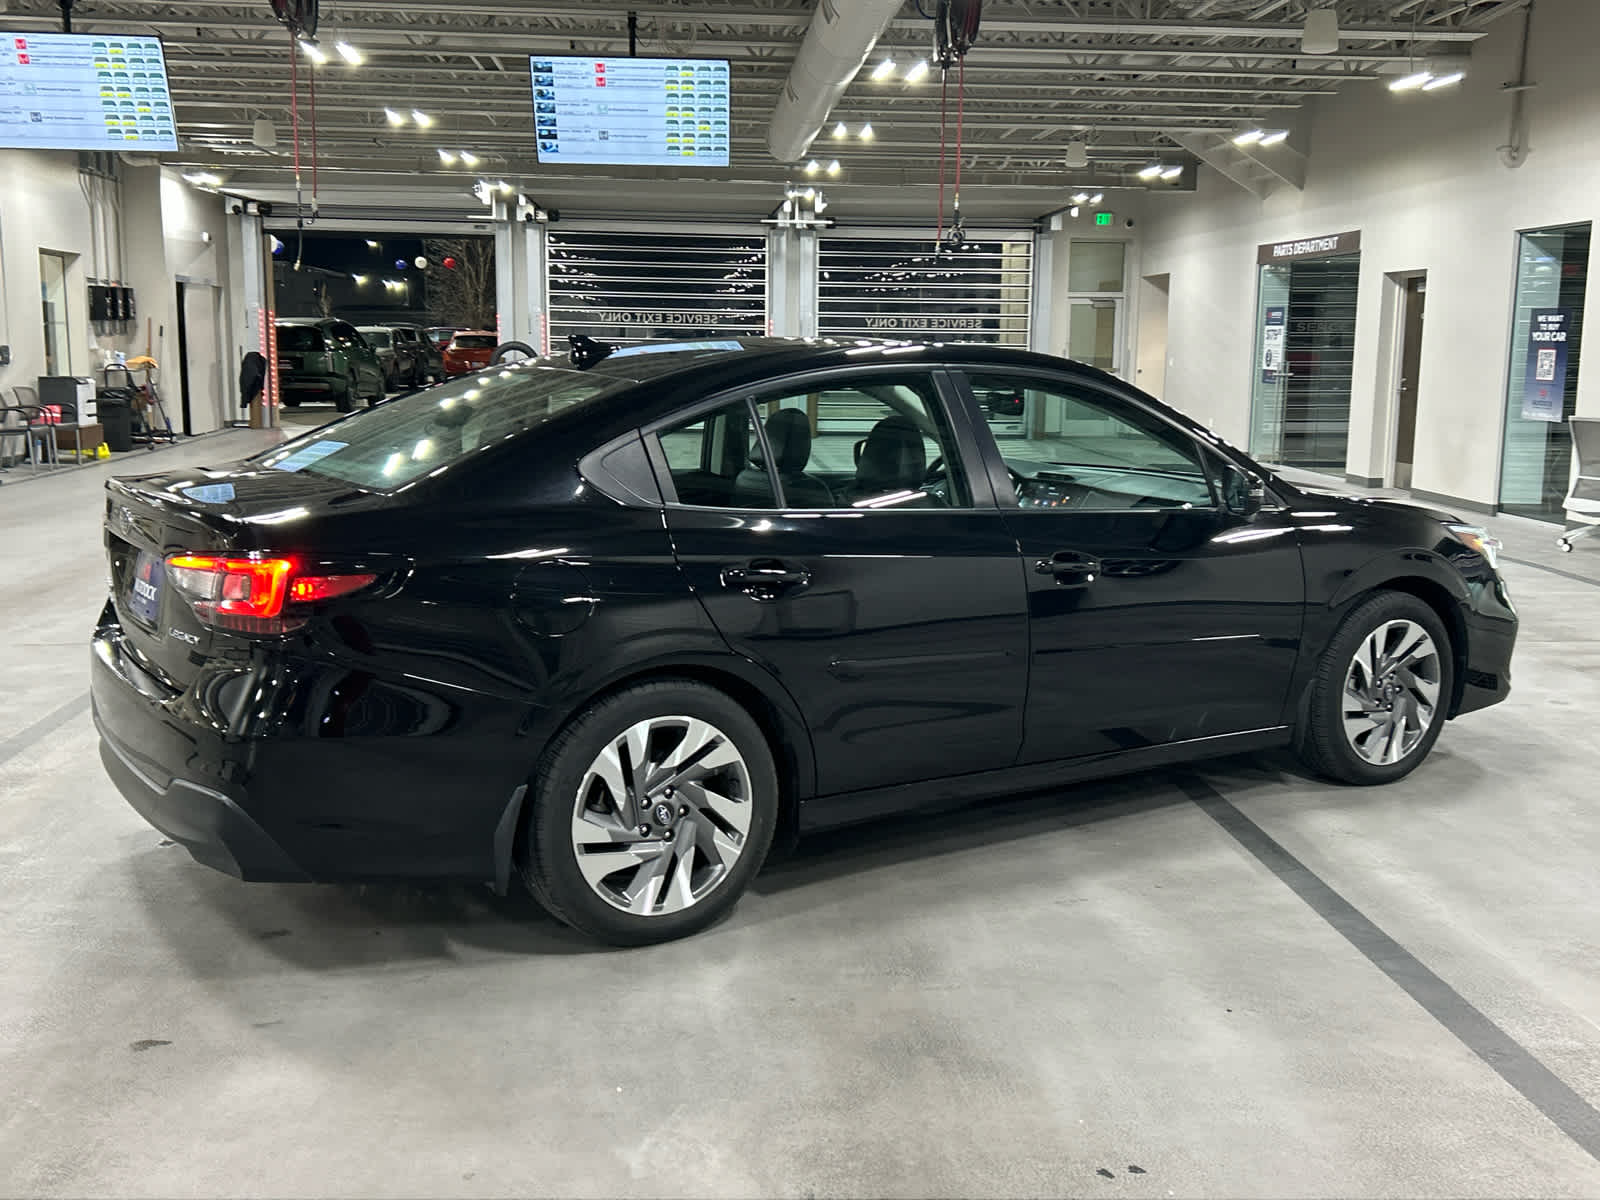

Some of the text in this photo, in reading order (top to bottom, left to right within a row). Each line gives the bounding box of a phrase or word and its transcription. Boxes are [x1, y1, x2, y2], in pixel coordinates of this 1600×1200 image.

[1273, 236, 1339, 257] PARTS DEPARTMENT
[1532, 331, 1567, 342] YOUR CAR
